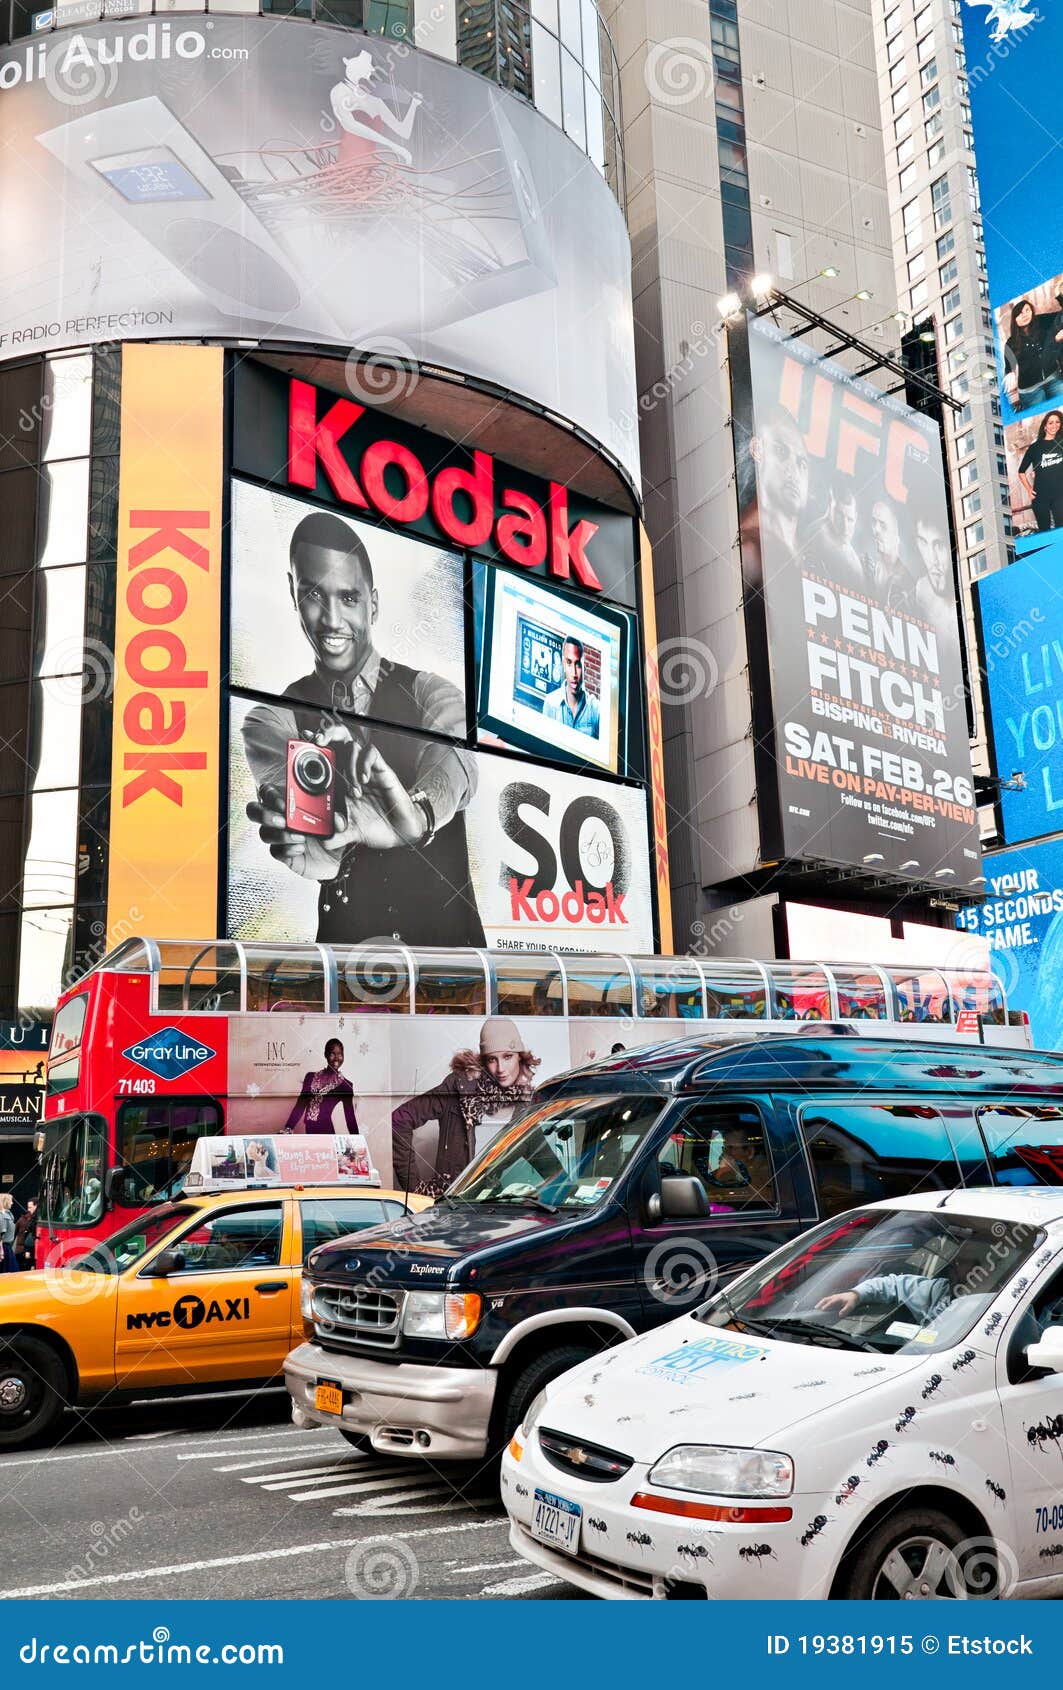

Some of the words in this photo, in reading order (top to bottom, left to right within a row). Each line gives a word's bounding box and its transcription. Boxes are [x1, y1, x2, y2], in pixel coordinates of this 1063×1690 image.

[0, 43, 46, 89] oli
[60, 23, 206, 73] Audio
[12, 322, 61, 345] RADIO
[65, 311, 173, 333] PERFECTION
[779, 356, 930, 503] UFC
[288, 377, 604, 592] Kodak
[802, 577, 940, 675] PENN
[121, 509, 210, 809] Kodak
[868, 649, 888, 667] VS
[807, 640, 945, 733] FITCH
[784, 721, 858, 773] SAT.
[811, 697, 883, 736] BISPING
[893, 724, 948, 757] RIVERA
[1005, 699, 1063, 758] YO
[785, 755, 830, 785] LIVE
[832, 770, 861, 793] ON
[863, 776, 975, 825] PAY-PER-VIEW
[841, 793, 863, 809] Follow
[863, 802, 872, 811] us
[873, 803, 881, 813] on
[881, 803, 936, 828] facebook.com/UFC
[500, 781, 633, 905] SO
[508, 876, 629, 924] Kodak
[990, 868, 1039, 896] YOUR
[959, 907, 979, 930] 15
[983, 889, 1063, 926] SECONDS
[496, 939, 524, 951] SHARE
[985, 922, 1039, 951] FAME.
[267, 1041, 286, 1060] INC
[118, 1079, 156, 1094] 71403
[410, 1264, 445, 1276] Explorer
[126, 1310, 172, 1331] NYC
[173, 1295, 250, 1330] TAXI
[650, 1347, 731, 1373] PEST
